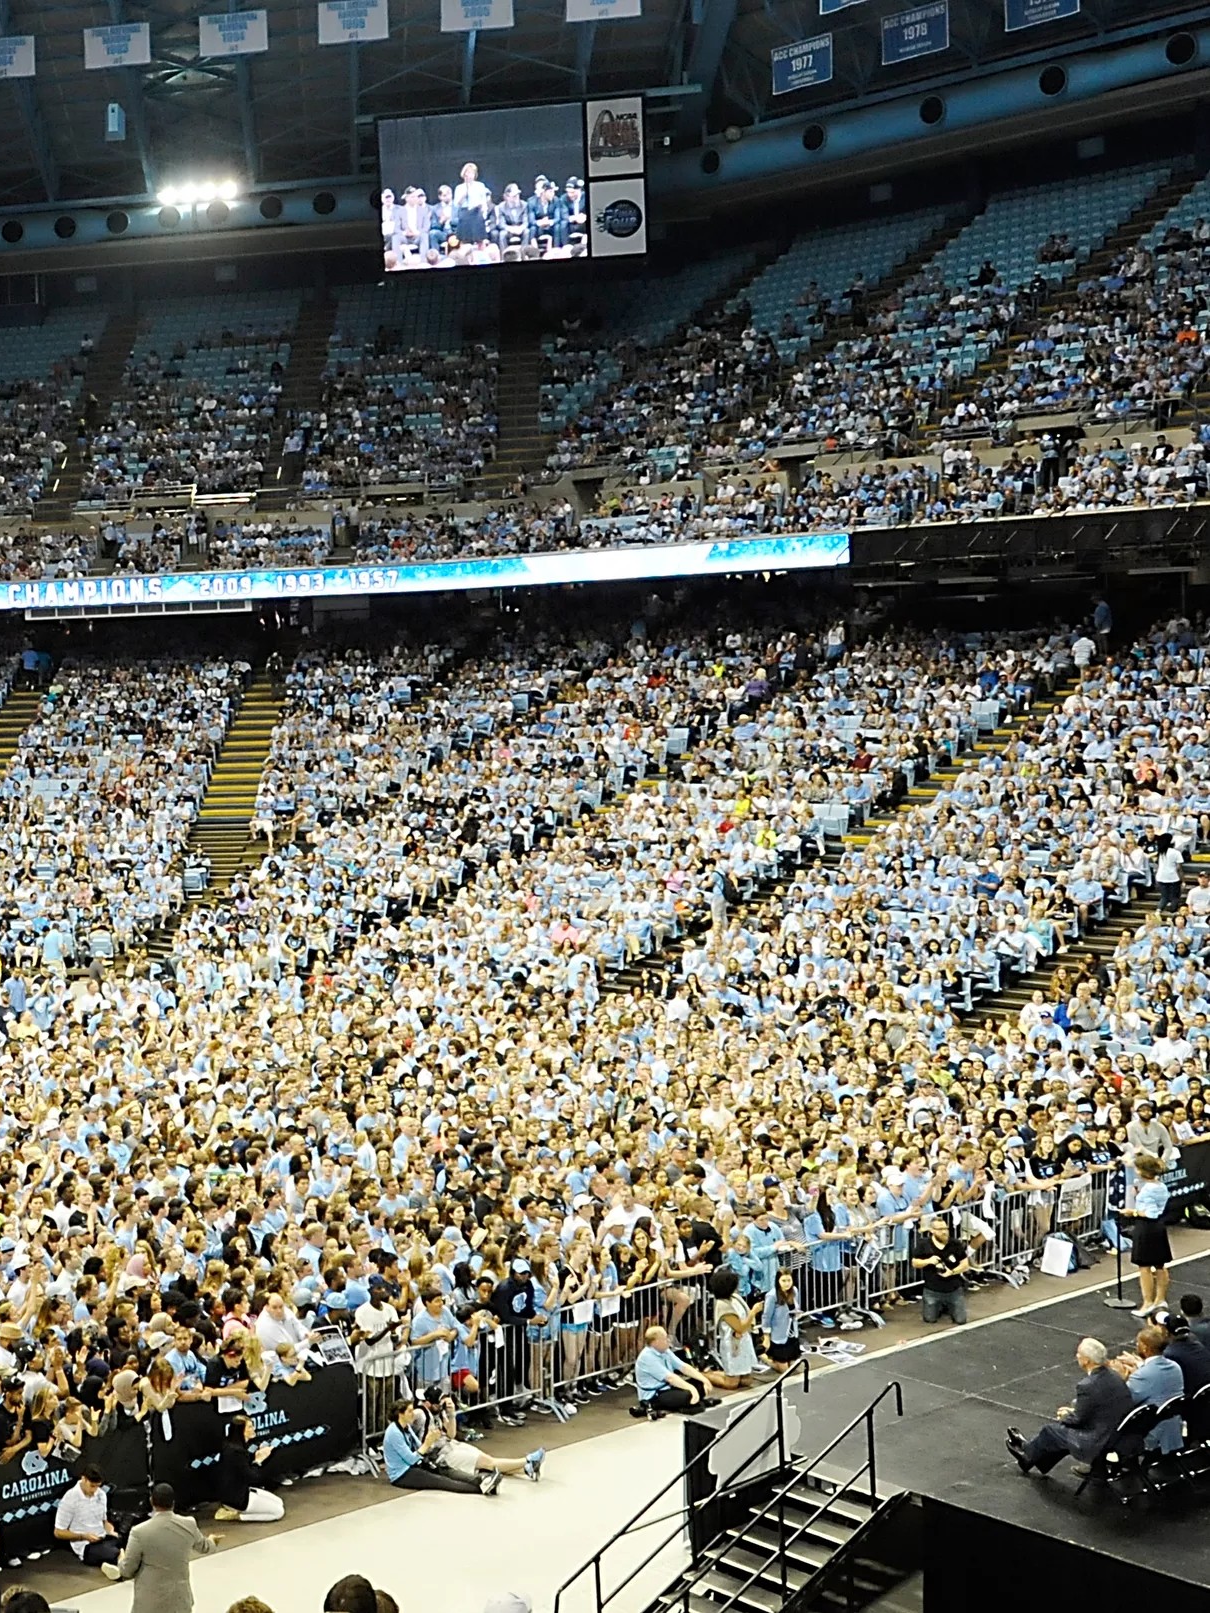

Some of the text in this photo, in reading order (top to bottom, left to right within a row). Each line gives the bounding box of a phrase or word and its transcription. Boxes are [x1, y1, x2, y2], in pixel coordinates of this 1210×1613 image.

[900, 4, 945, 25] CHAMPIONS
[902, 22, 928, 40] 1978
[773, 37, 830, 61] ACC CHAMPIONS
[790, 54, 814, 72] 1977
[7, 578, 162, 608] CHAMPIONS
[198, 576, 252, 597] 2009
[276, 573, 325, 593] 1993
[350, 569, 399, 590] 1957
[1, 1468, 71, 1500] CAROLINA
